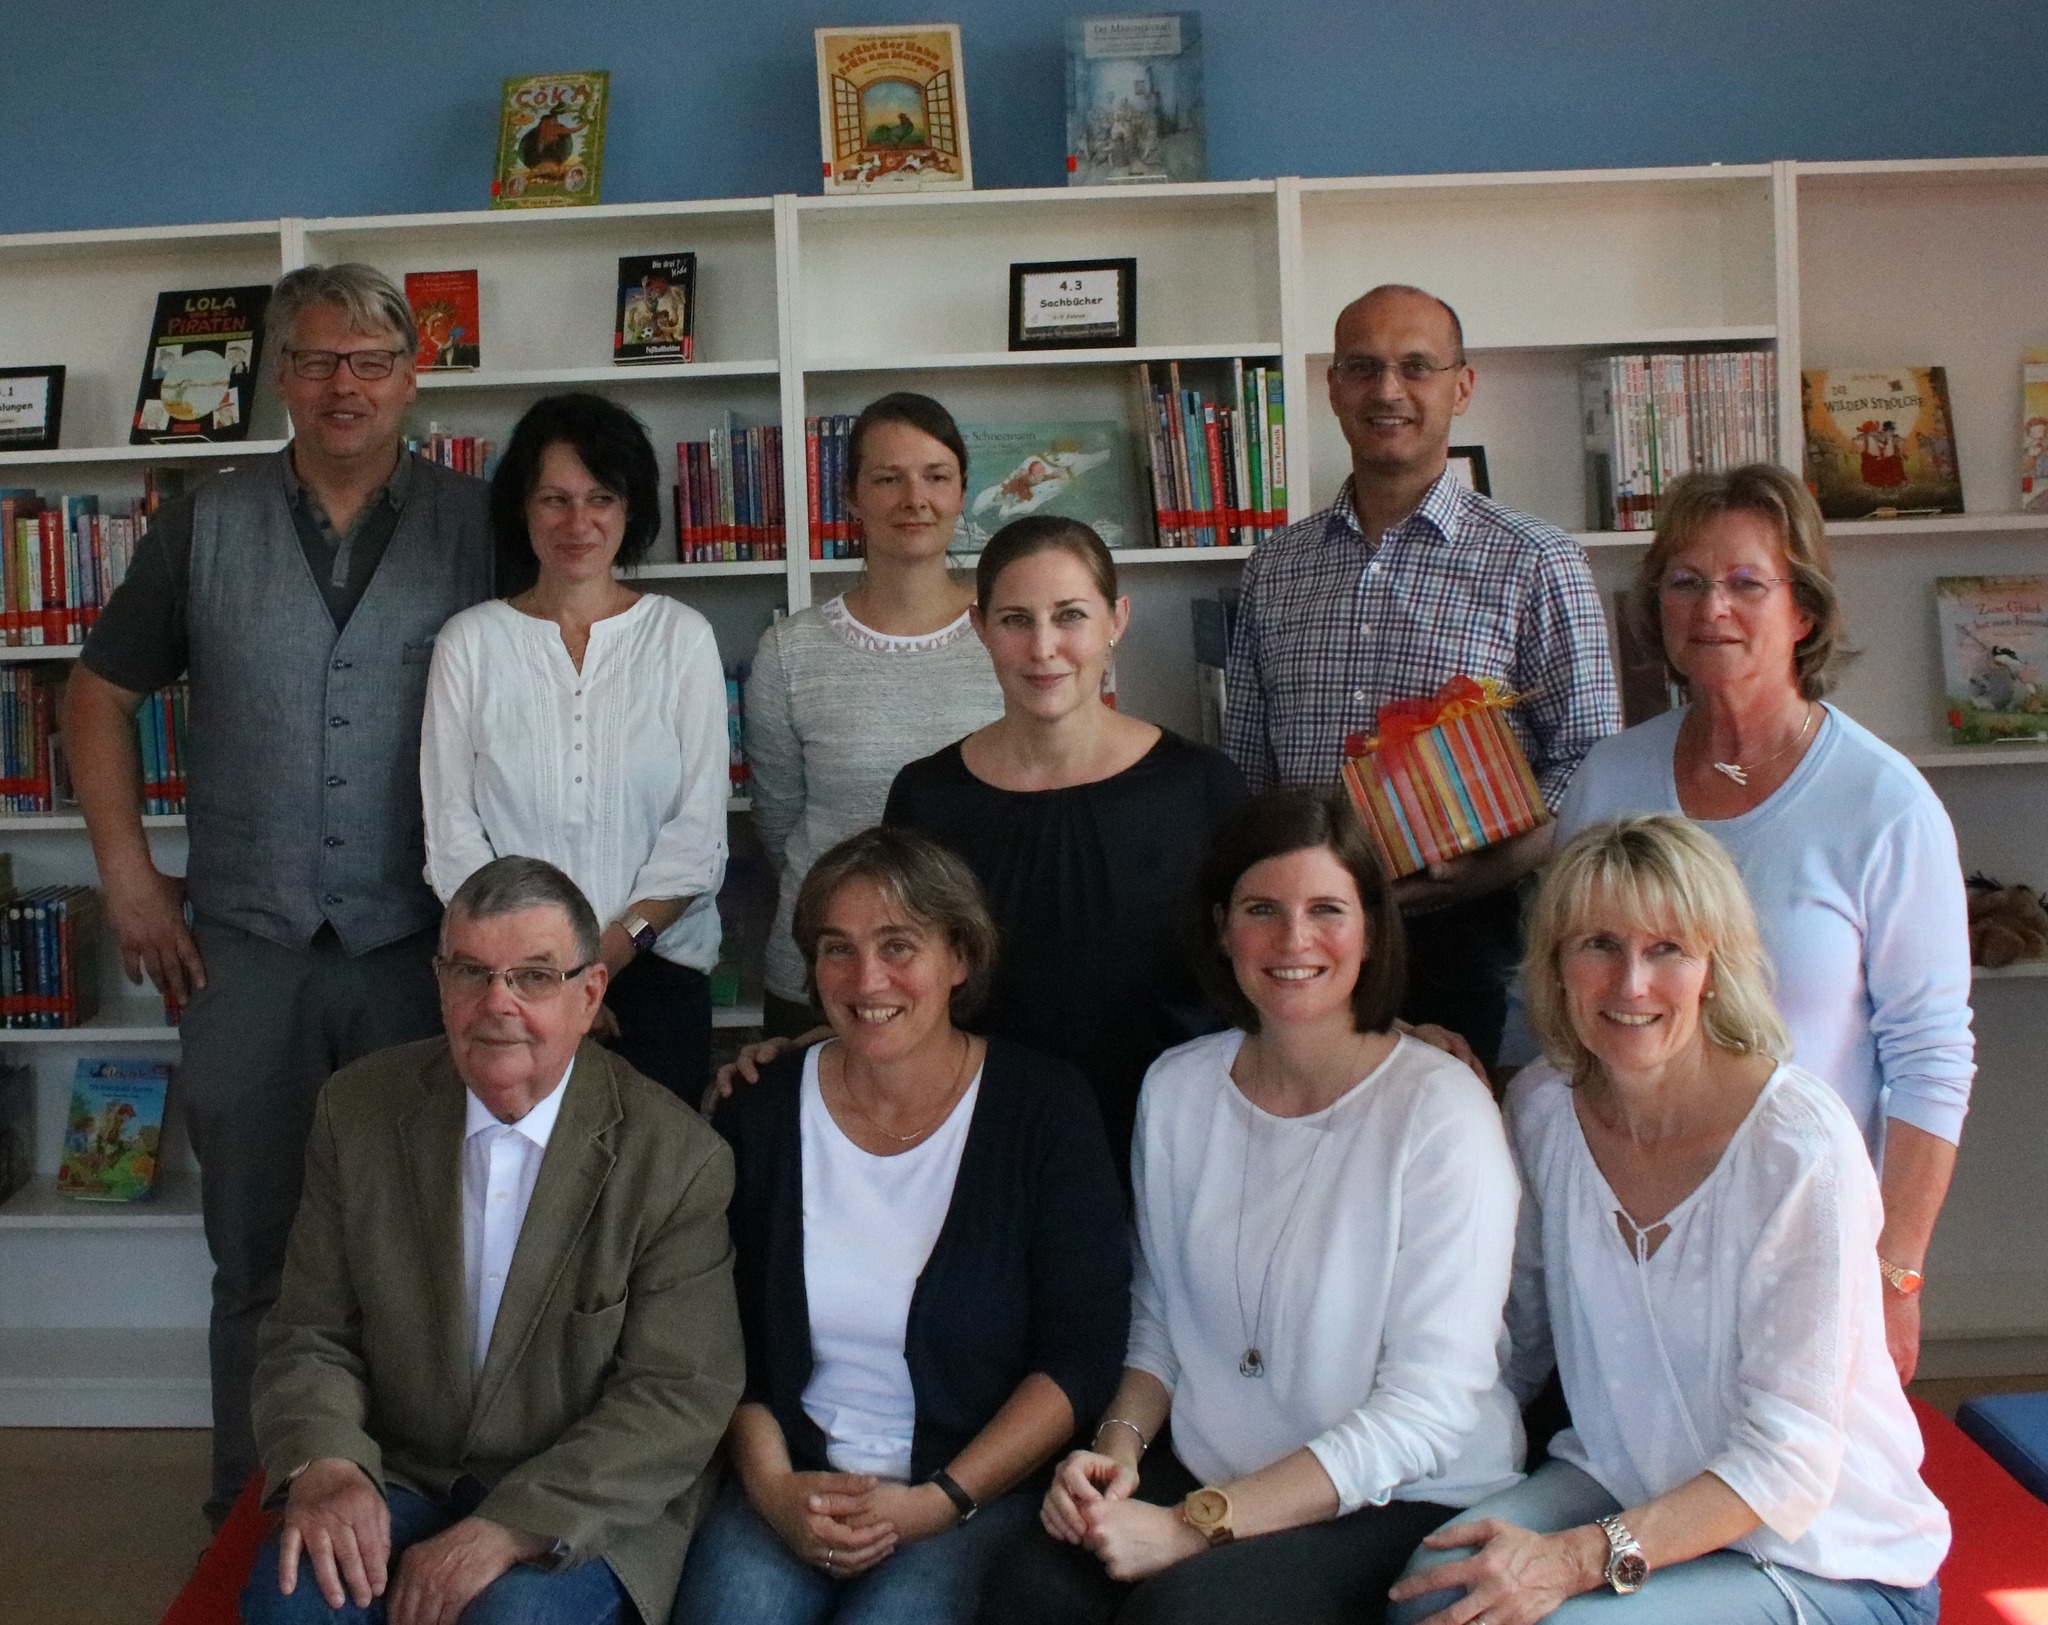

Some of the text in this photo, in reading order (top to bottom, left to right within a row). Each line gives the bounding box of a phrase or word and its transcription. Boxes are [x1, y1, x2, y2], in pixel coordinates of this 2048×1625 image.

[880, 41, 904, 49] der
[1060, 280, 1082, 291] 4.3
[185, 297, 236, 312] LOLA
[1040, 297, 1103, 308] Sachbücher
[168, 315, 247, 334] PIRATEN
[1825, 395, 1923, 412] WILDEN STROLCHE
[972, 430, 1036, 442] Schneemann
[1274, 428, 1282, 459] Technik
